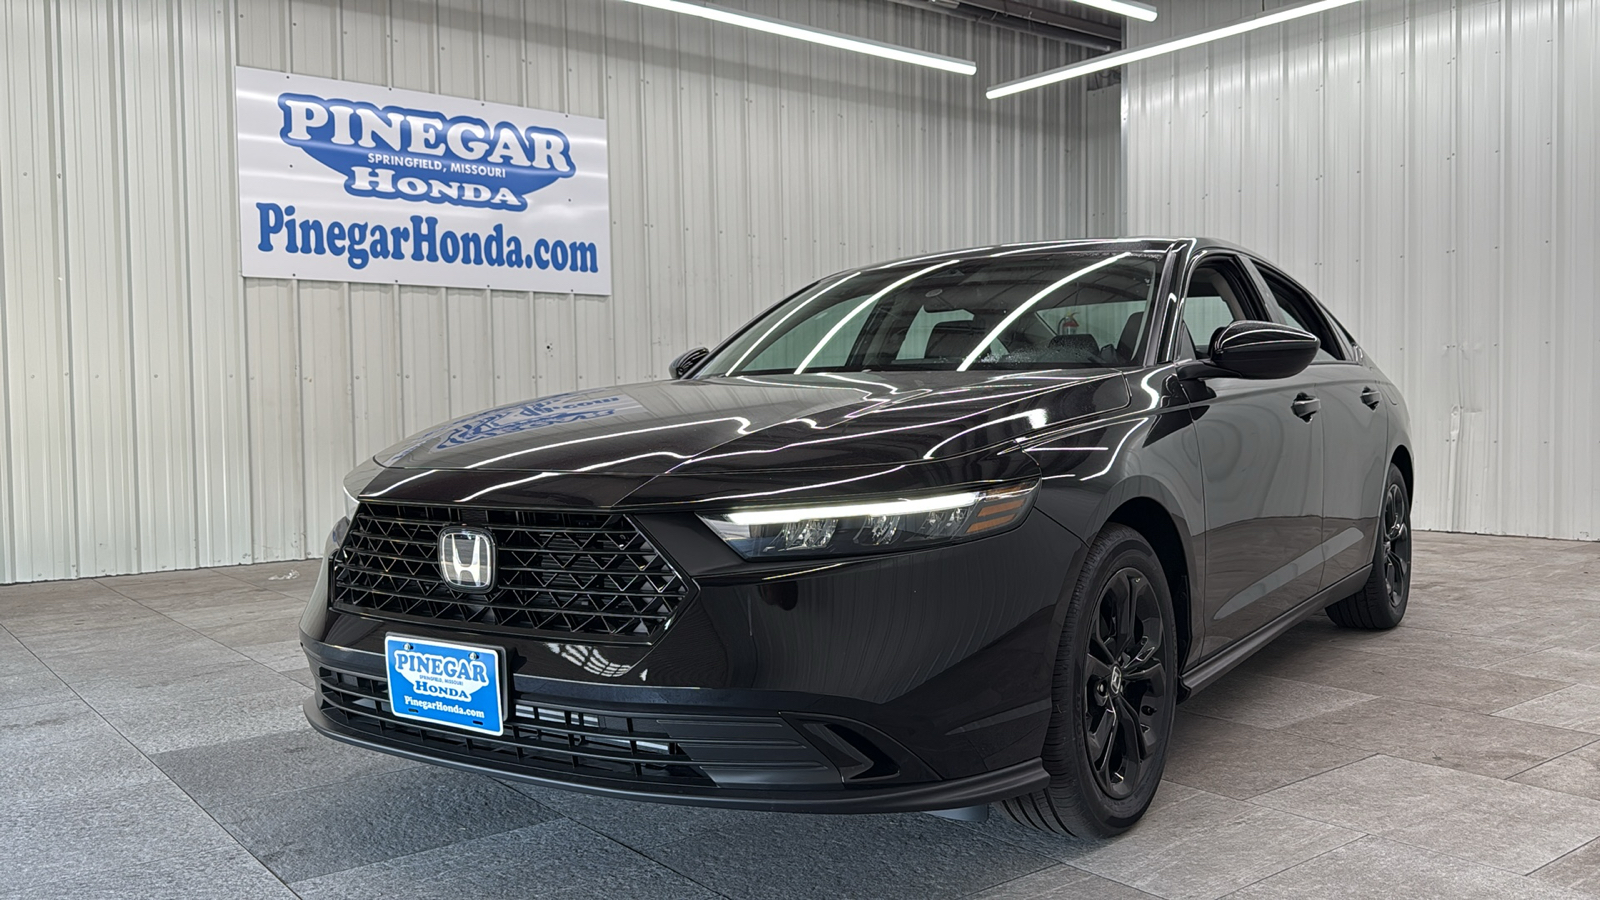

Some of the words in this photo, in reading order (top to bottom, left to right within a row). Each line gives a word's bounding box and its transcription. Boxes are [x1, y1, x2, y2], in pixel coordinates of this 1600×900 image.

[284, 98, 571, 174] PINEGAR
[367, 152, 447, 173] SPRINGFIELD,
[450, 162, 506, 179] MISSOURI
[351, 166, 522, 206] HONDA
[255, 202, 599, 273] PinegarHonda.com
[396, 653, 487, 683] PINEGAR
[415, 680, 470, 699] HONDA
[404, 695, 485, 718] PinegarHonda.com
